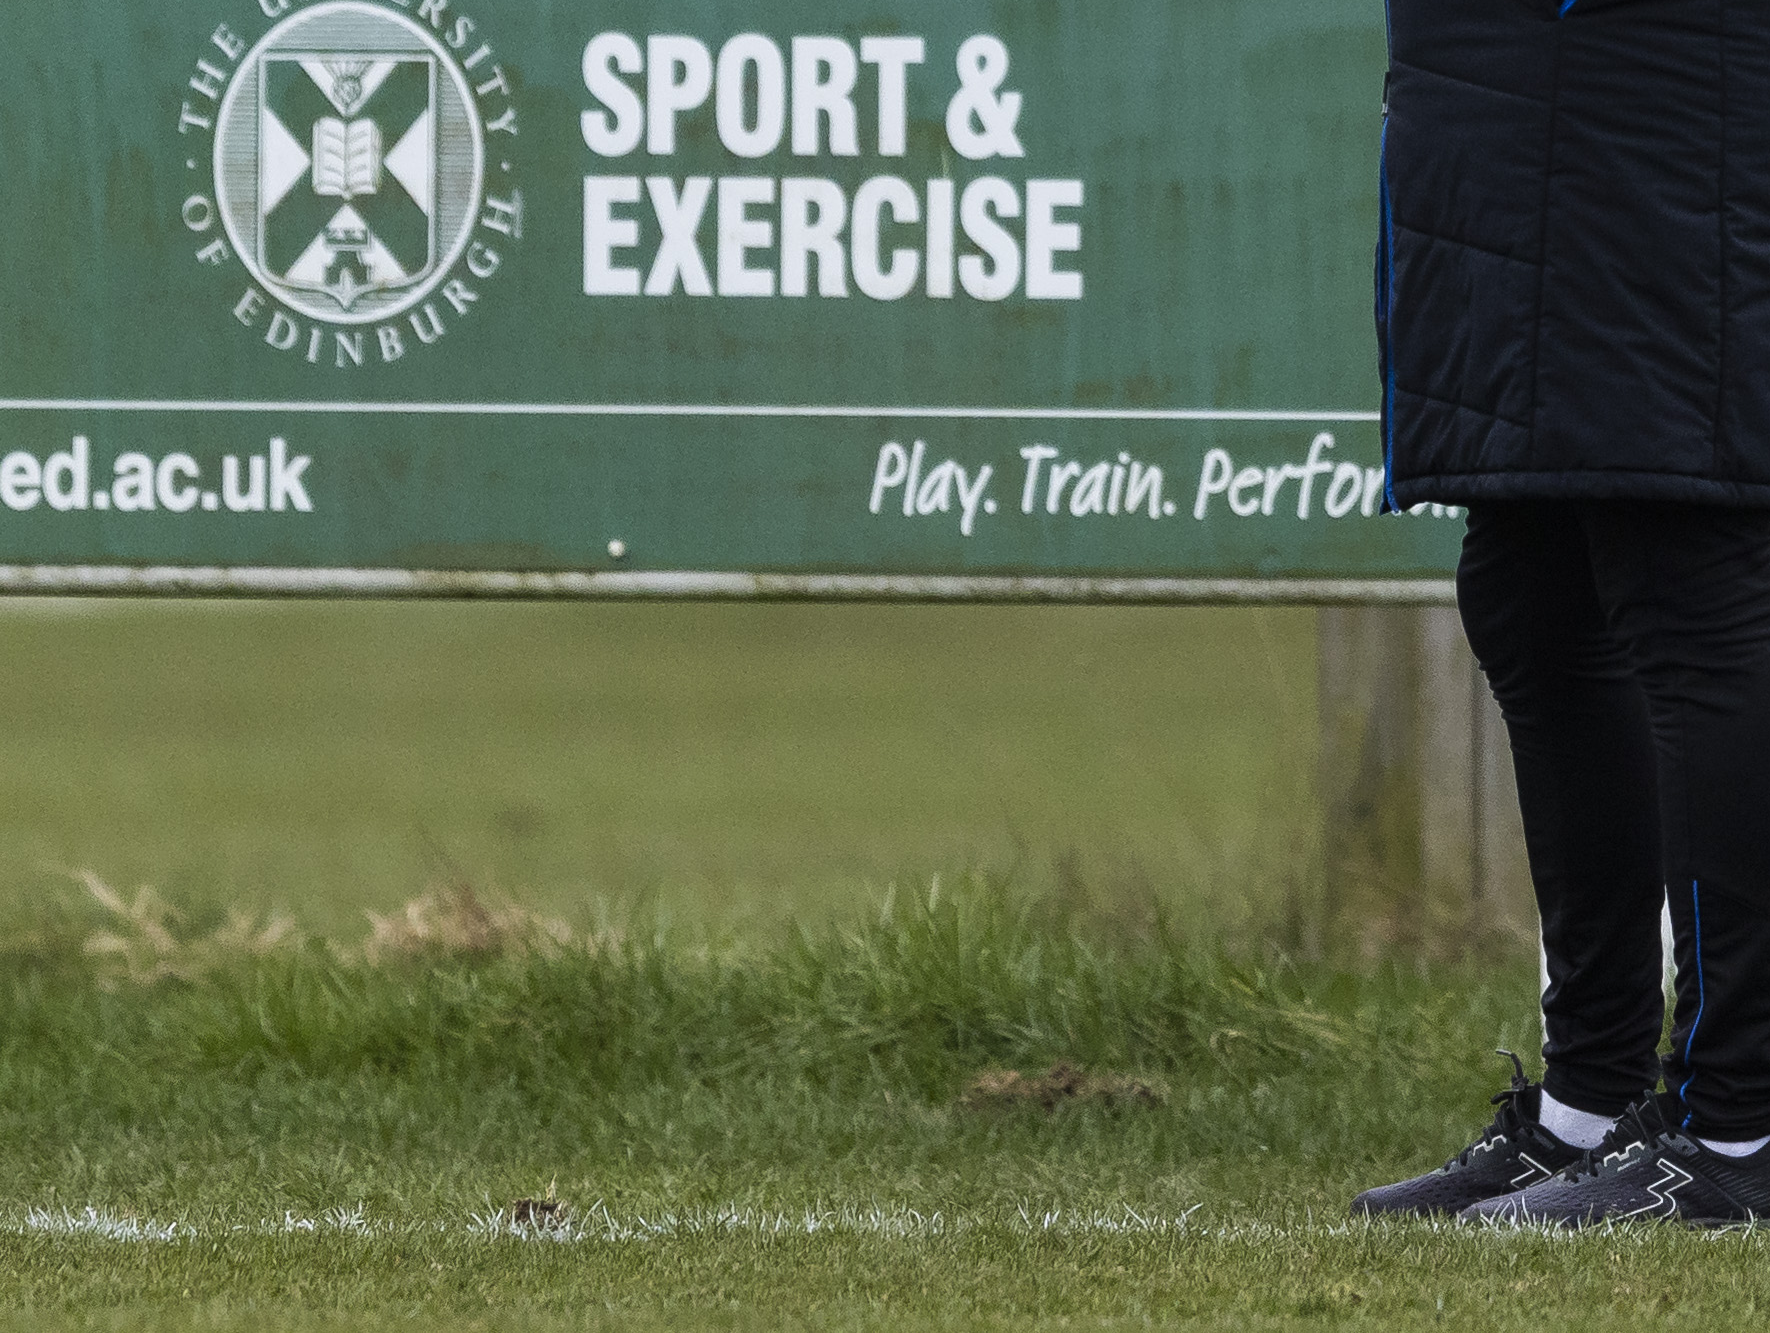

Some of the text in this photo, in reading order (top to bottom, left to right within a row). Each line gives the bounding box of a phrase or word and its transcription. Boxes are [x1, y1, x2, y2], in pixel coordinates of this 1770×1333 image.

[177, 21, 247, 134] THE
[581, 30, 1026, 160] SPORT &
[181, 187, 525, 369] OF EDINBURGH
[582, 174, 1086, 303] EXERCISE
[0, 434, 314, 513] ed.ac.uk
[868, 439, 998, 537] Play.
[1019, 443, 1177, 520] Train.
